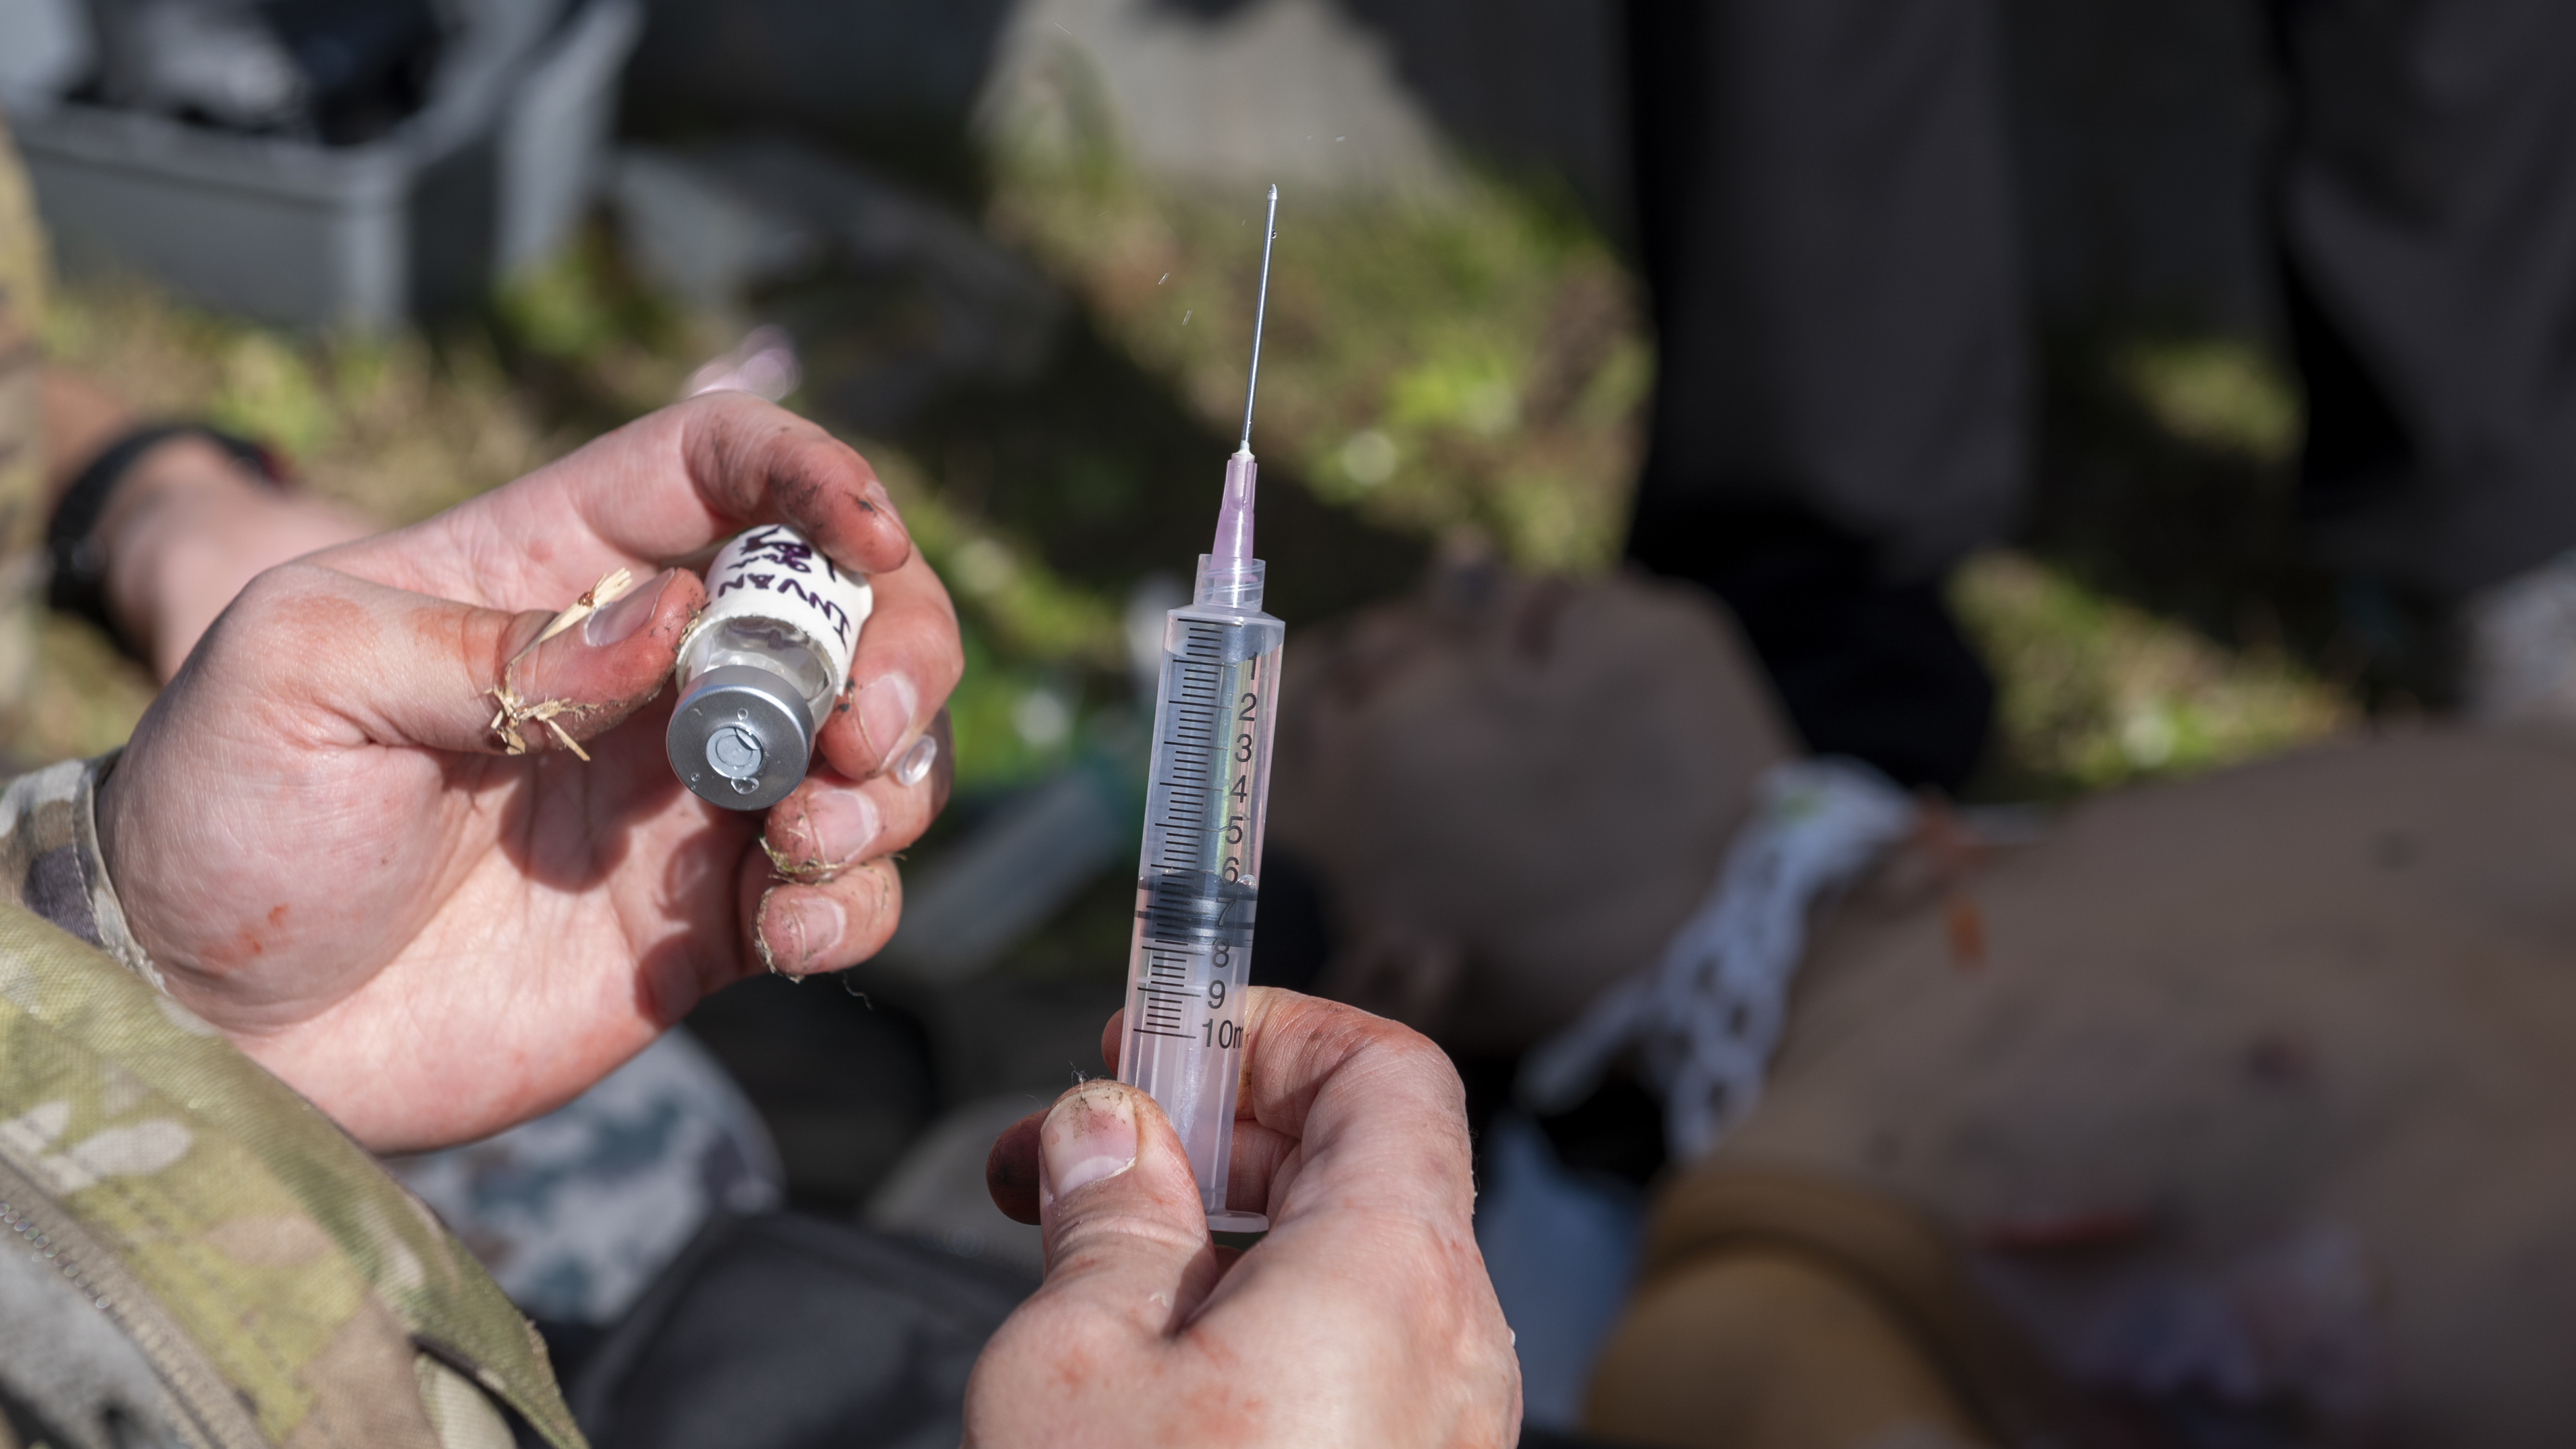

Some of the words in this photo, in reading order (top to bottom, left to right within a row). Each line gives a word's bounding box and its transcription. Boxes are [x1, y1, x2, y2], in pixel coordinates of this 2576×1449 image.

[700, 573, 851, 652] INVAN
[1248, 651, 1258, 681] 1
[1238, 693, 1257, 722] 2
[1234, 733, 1252, 763] 3
[1229, 775, 1248, 803] 4
[1225, 816, 1244, 844] 5
[1221, 856, 1239, 886] 6
[1216, 897, 1236, 927] 7
[1211, 938, 1229, 968] 8
[1208, 980, 1226, 1009] 9
[1202, 1018, 1244, 1049] 10m
